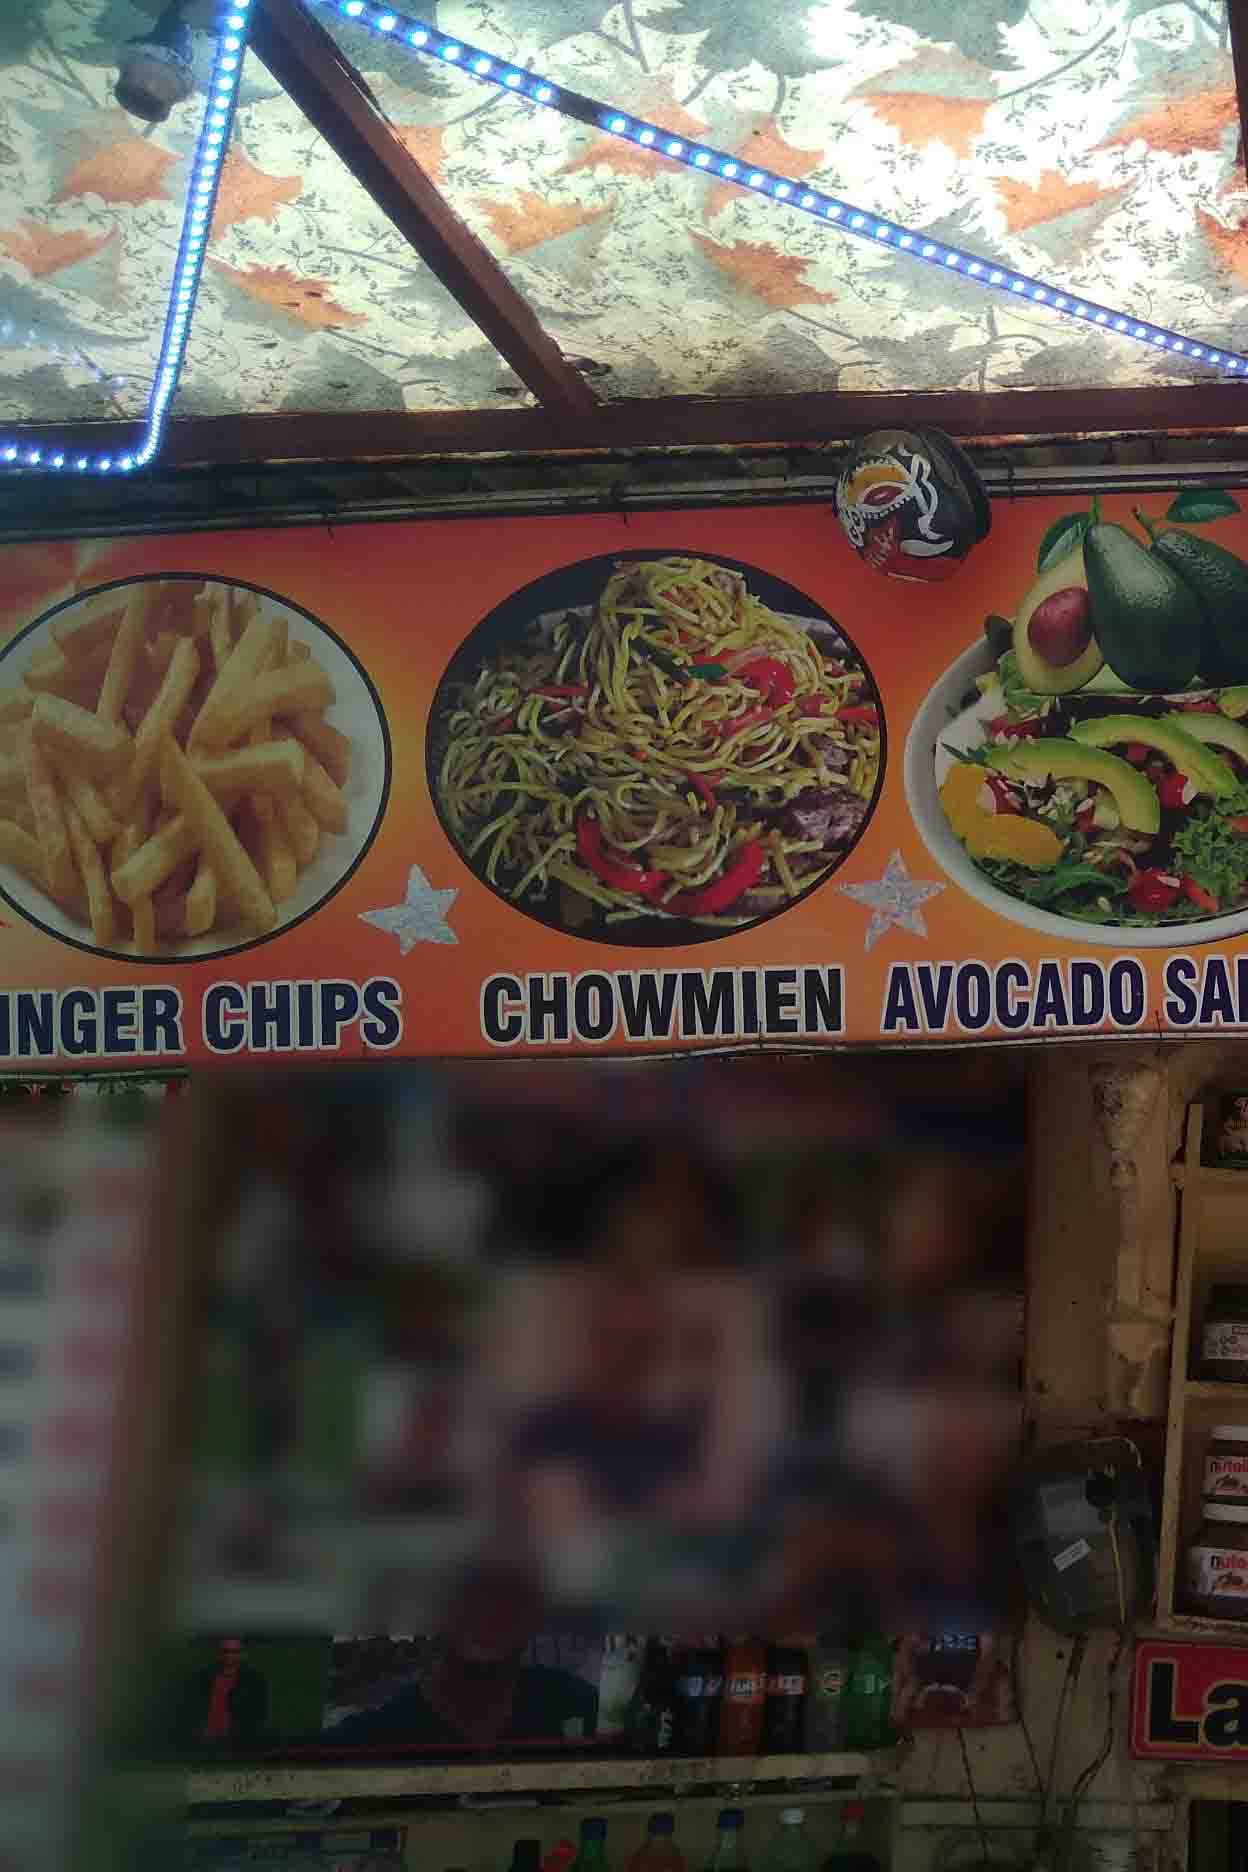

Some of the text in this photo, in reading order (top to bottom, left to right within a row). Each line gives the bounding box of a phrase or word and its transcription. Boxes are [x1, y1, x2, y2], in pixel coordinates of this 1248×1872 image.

[203, 979, 402, 1051] CHIPS
[483, 966, 843, 1042] CHOWMIEN
[886, 958, 1146, 1031] AVOCADO
